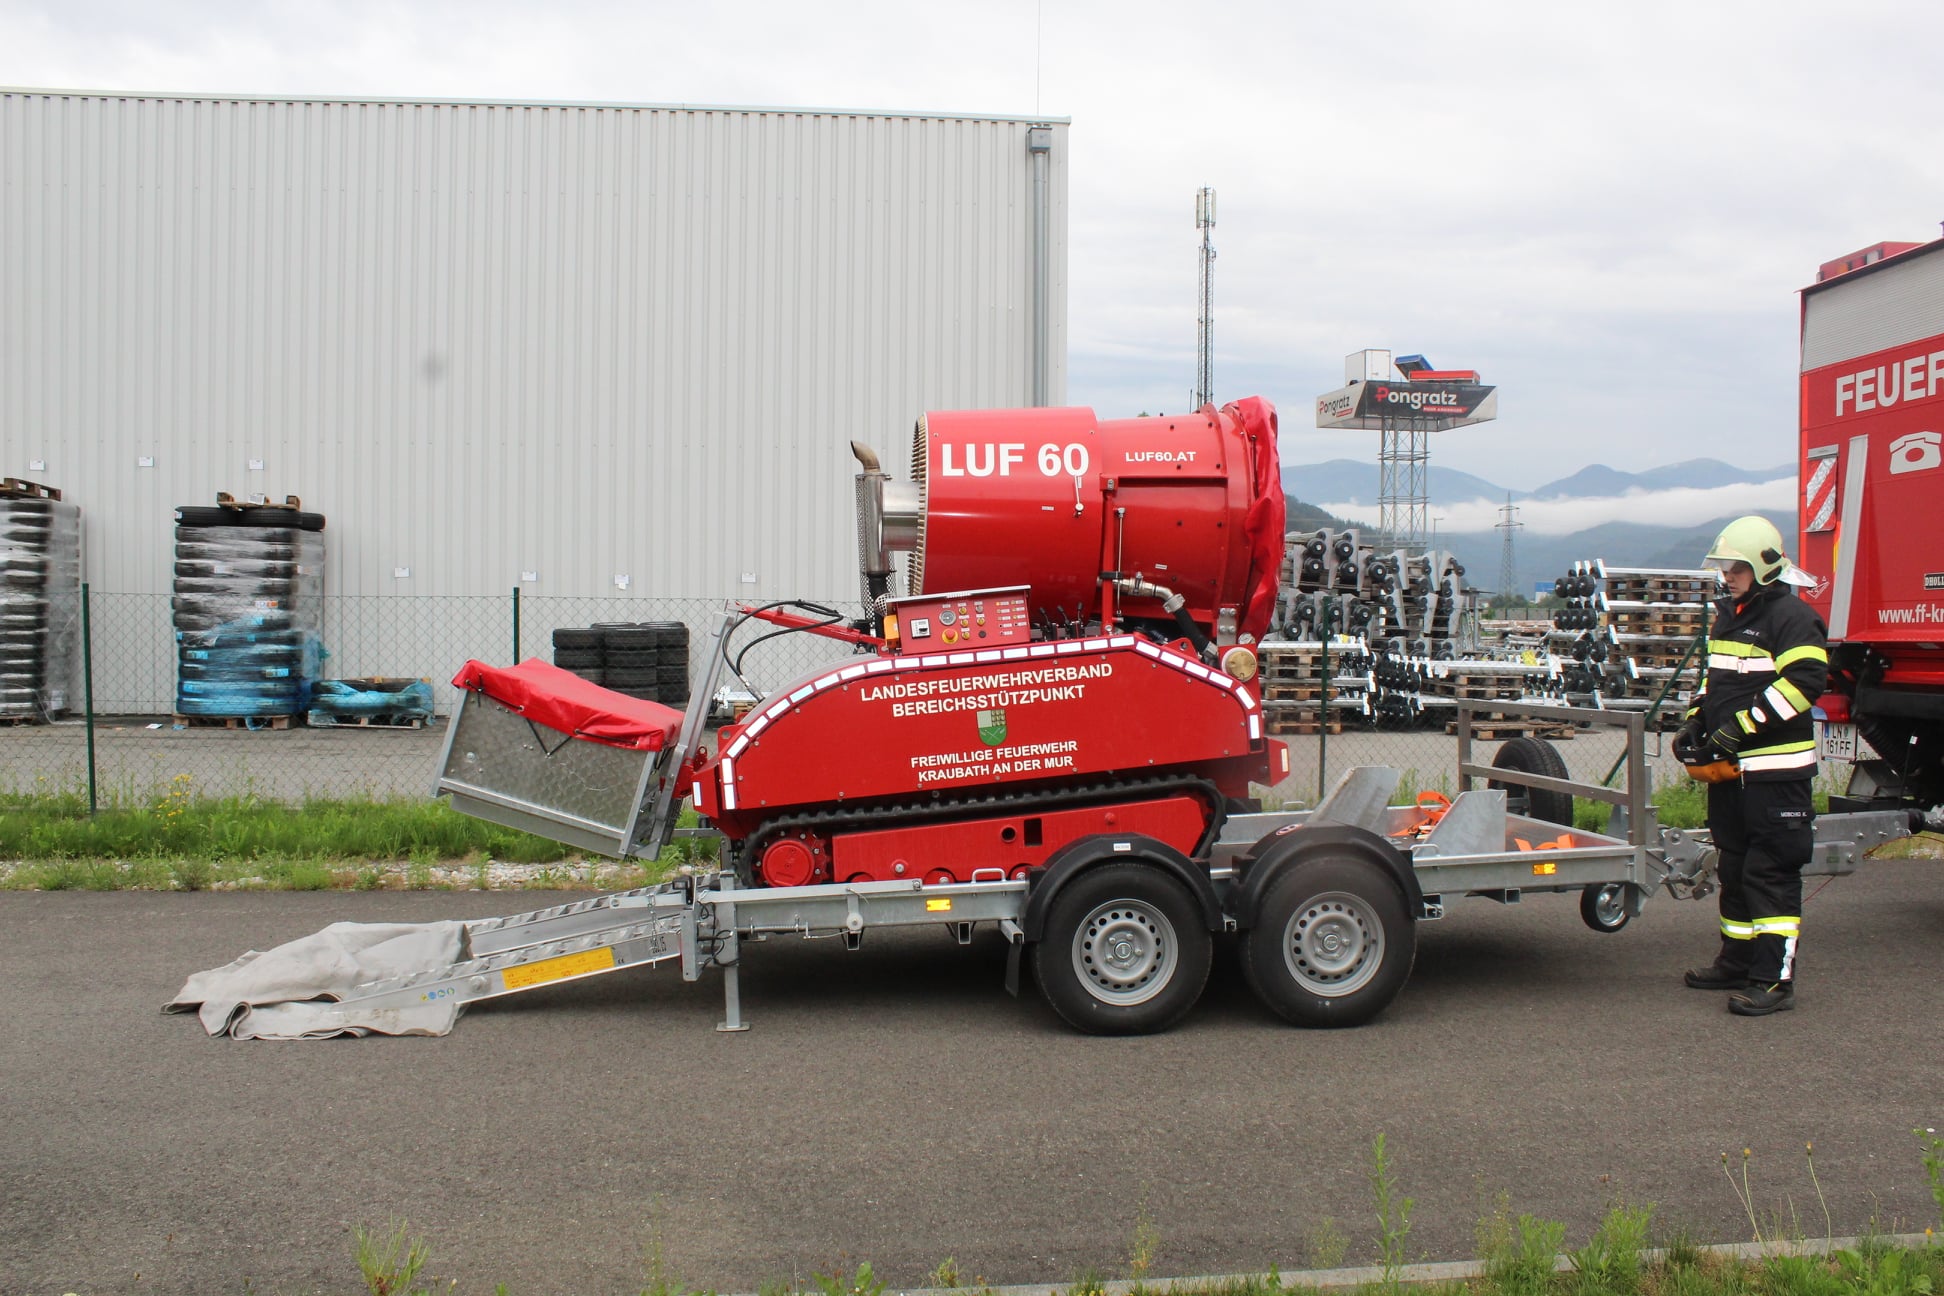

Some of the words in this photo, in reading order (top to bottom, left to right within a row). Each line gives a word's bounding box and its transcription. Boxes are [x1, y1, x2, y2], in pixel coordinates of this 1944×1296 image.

[1375, 386, 1457, 410] Pongratz
[1836, 351, 1944, 416] FEUER
[1318, 395, 1350, 416] Pongratz
[941, 442, 1025, 477] LUF
[1037, 442, 1090, 477] 60
[1125, 451, 1197, 463] LUF60.AT
[860, 663, 1113, 701] LANDESFEUERWEHRVERBAND
[892, 684, 1085, 717] BEREICHSSTÜTZPUNKT
[910, 749, 994, 769] FREIWILLIGE
[996, 740, 1078, 760] FEUERWEHR
[918, 764, 990, 782] KRAUBATH
[993, 763, 1011, 774] AN
[1014, 759, 1042, 772] DER
[1044, 755, 1074, 769] MUR
